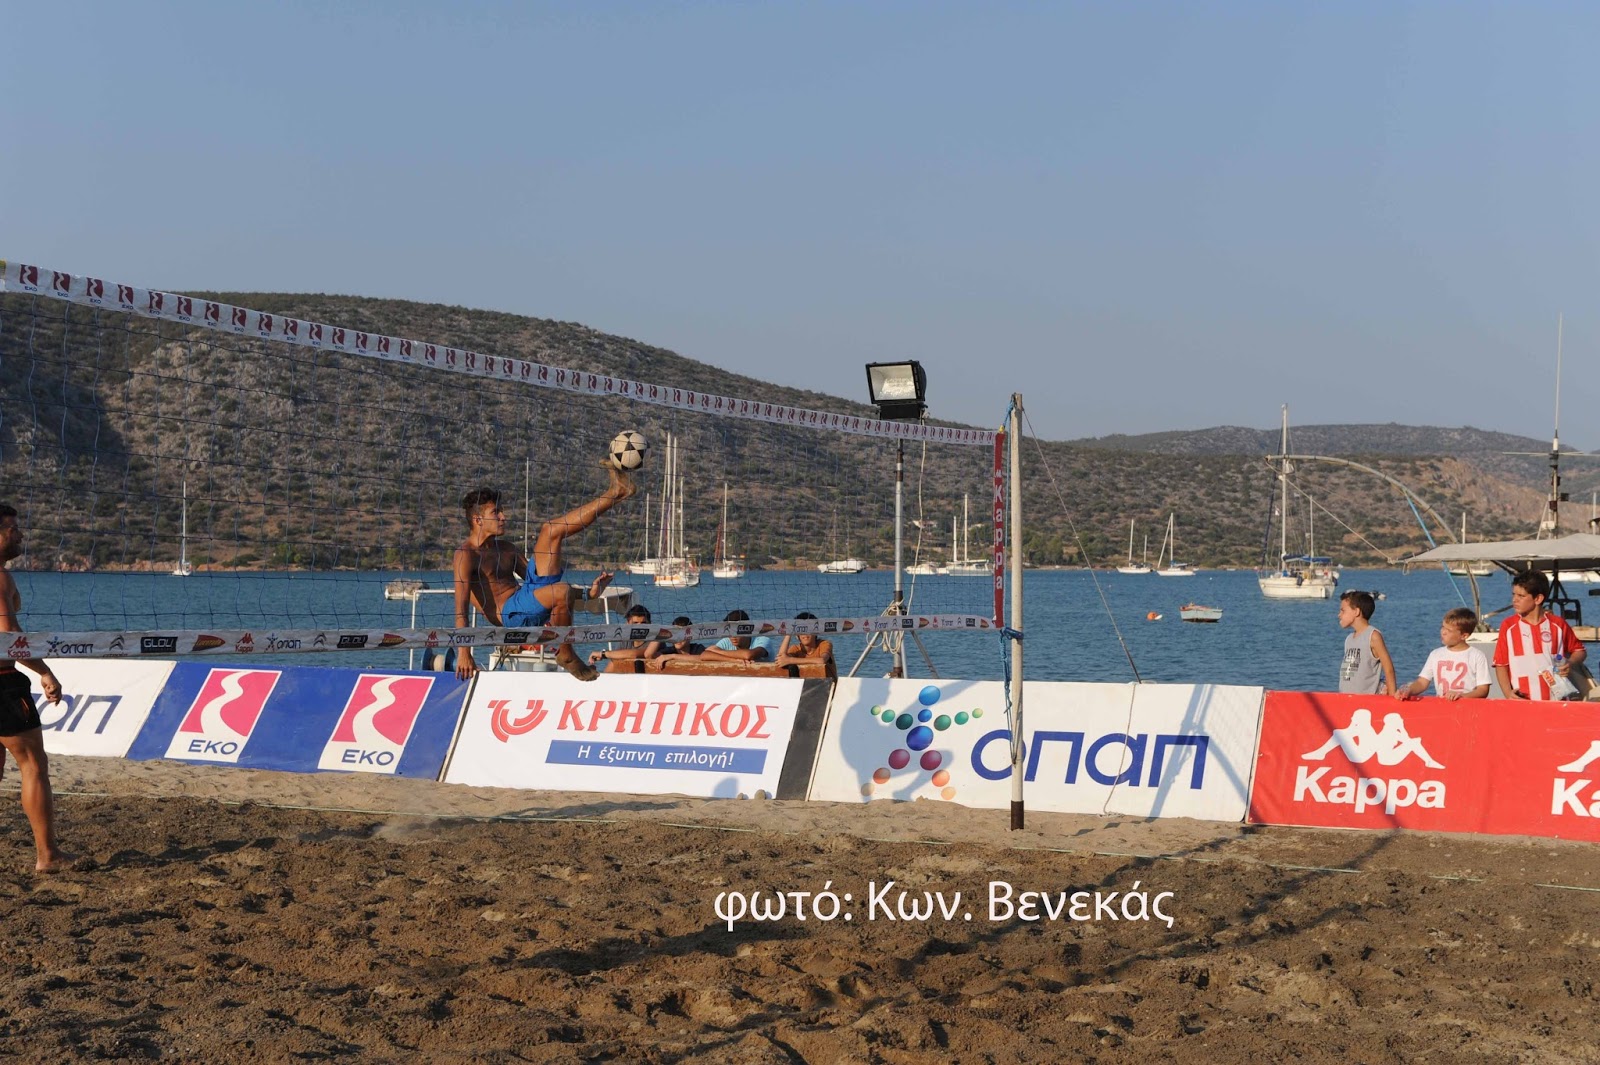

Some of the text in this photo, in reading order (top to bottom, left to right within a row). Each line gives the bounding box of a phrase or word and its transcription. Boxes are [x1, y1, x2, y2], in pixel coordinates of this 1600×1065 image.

[995, 484, 1003, 590] Kappa
[8, 649, 31, 659] Kappa
[556, 699, 779, 739] ΚΡΗΤΙΚΟΣ
[188, 739, 238, 755] EKO
[341, 749, 395, 766] EKO
[577, 745, 735, 768] Η έξυπνη επιλογή!
[1293, 765, 1447, 815] Kappa
